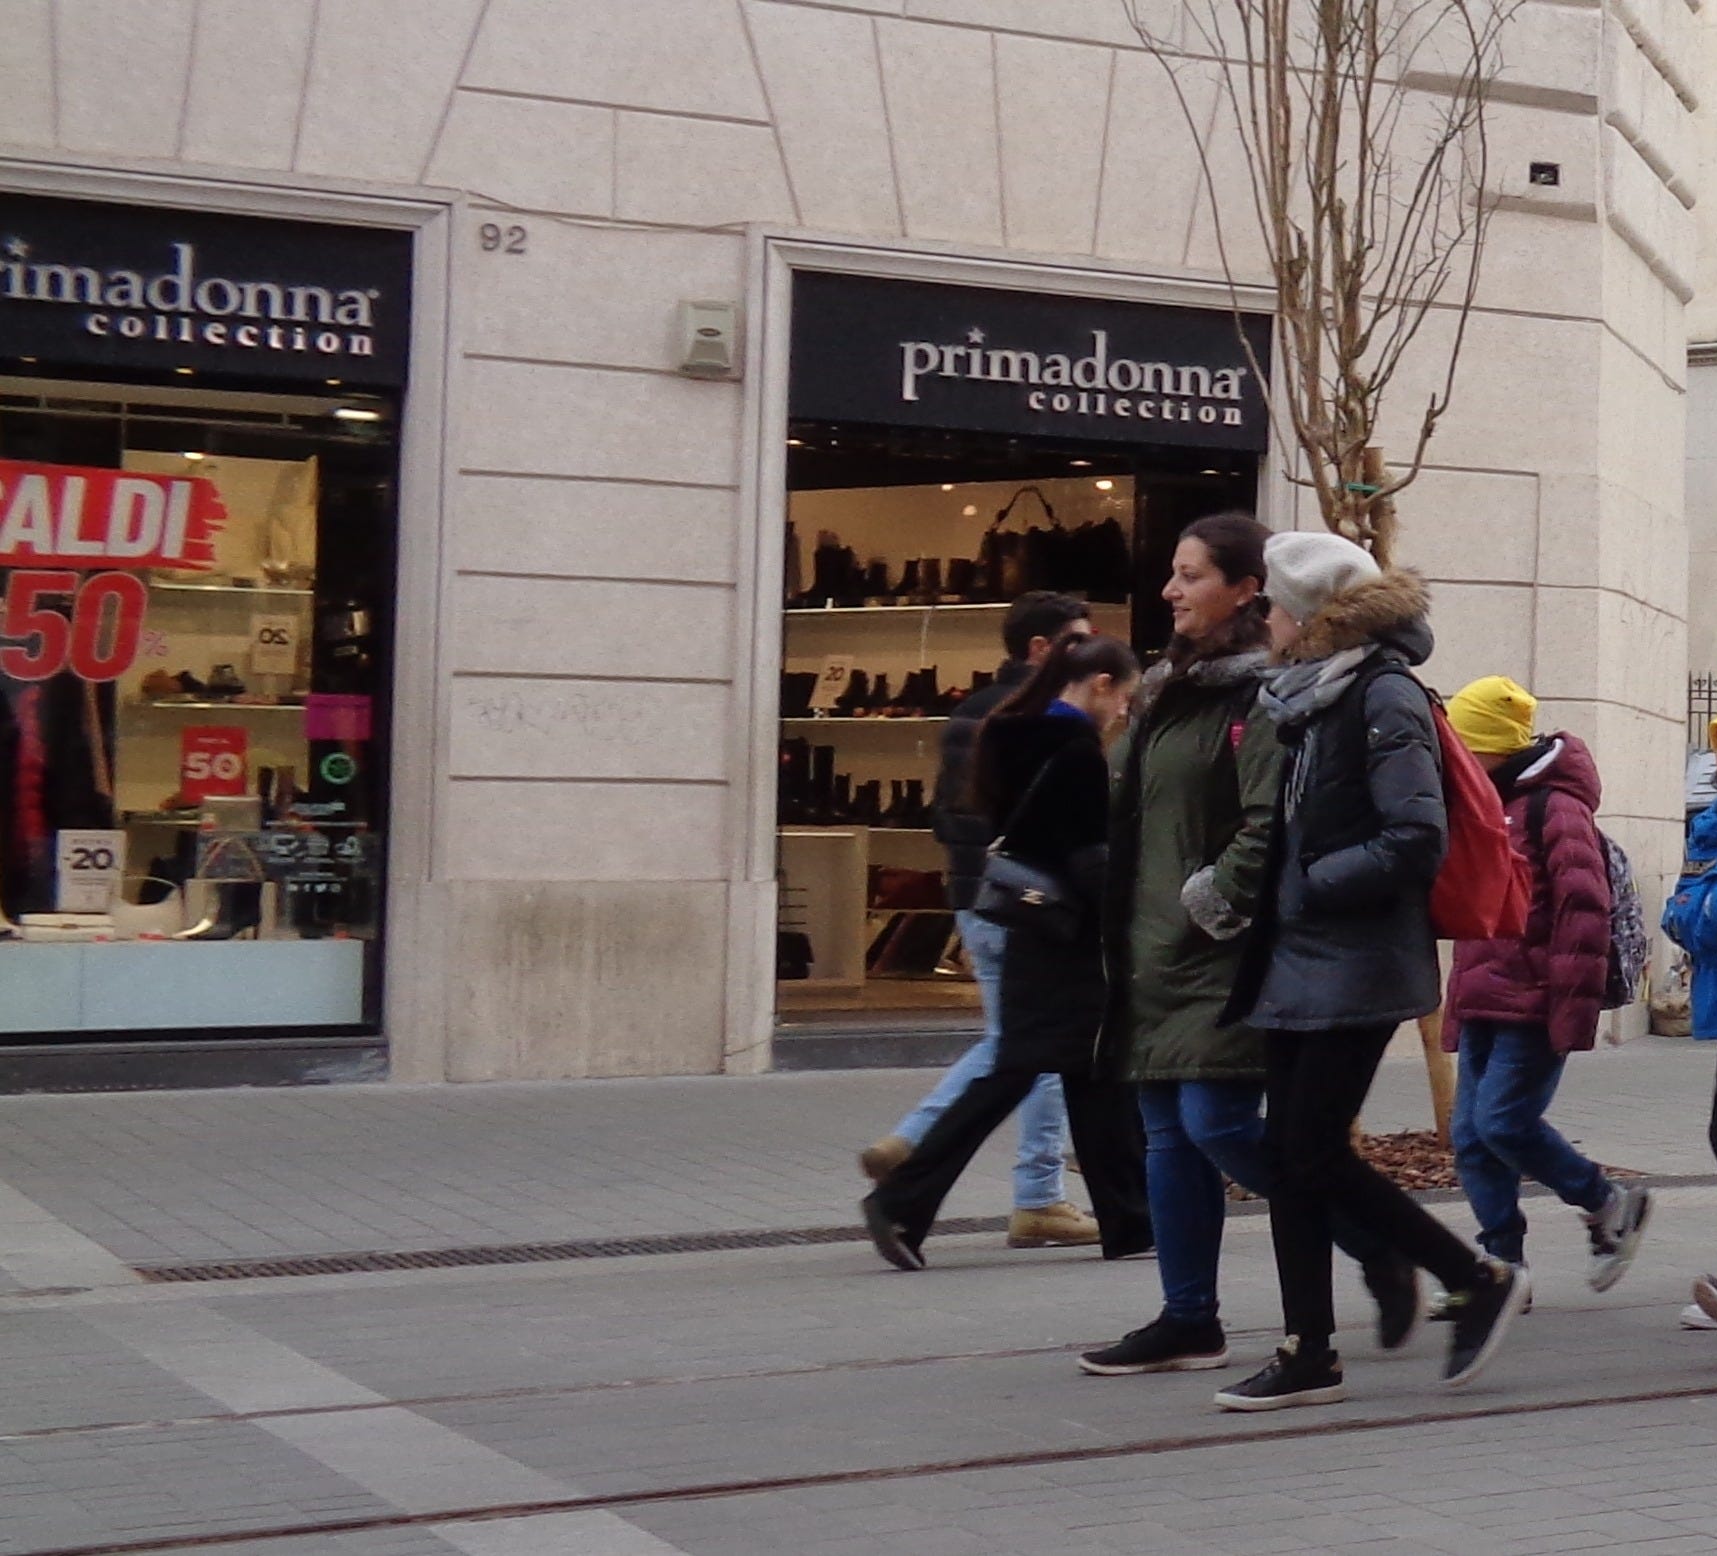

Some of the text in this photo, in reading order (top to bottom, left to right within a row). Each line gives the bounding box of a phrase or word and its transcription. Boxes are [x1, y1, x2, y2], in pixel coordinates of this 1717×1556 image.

[479, 223, 527, 254] 92
[0, 239, 374, 328] imadonna
[86, 311, 375, 356] collection
[900, 327, 1243, 401] primadonna
[1028, 389, 1242, 426] collection
[0, 473, 192, 559] ALDI
